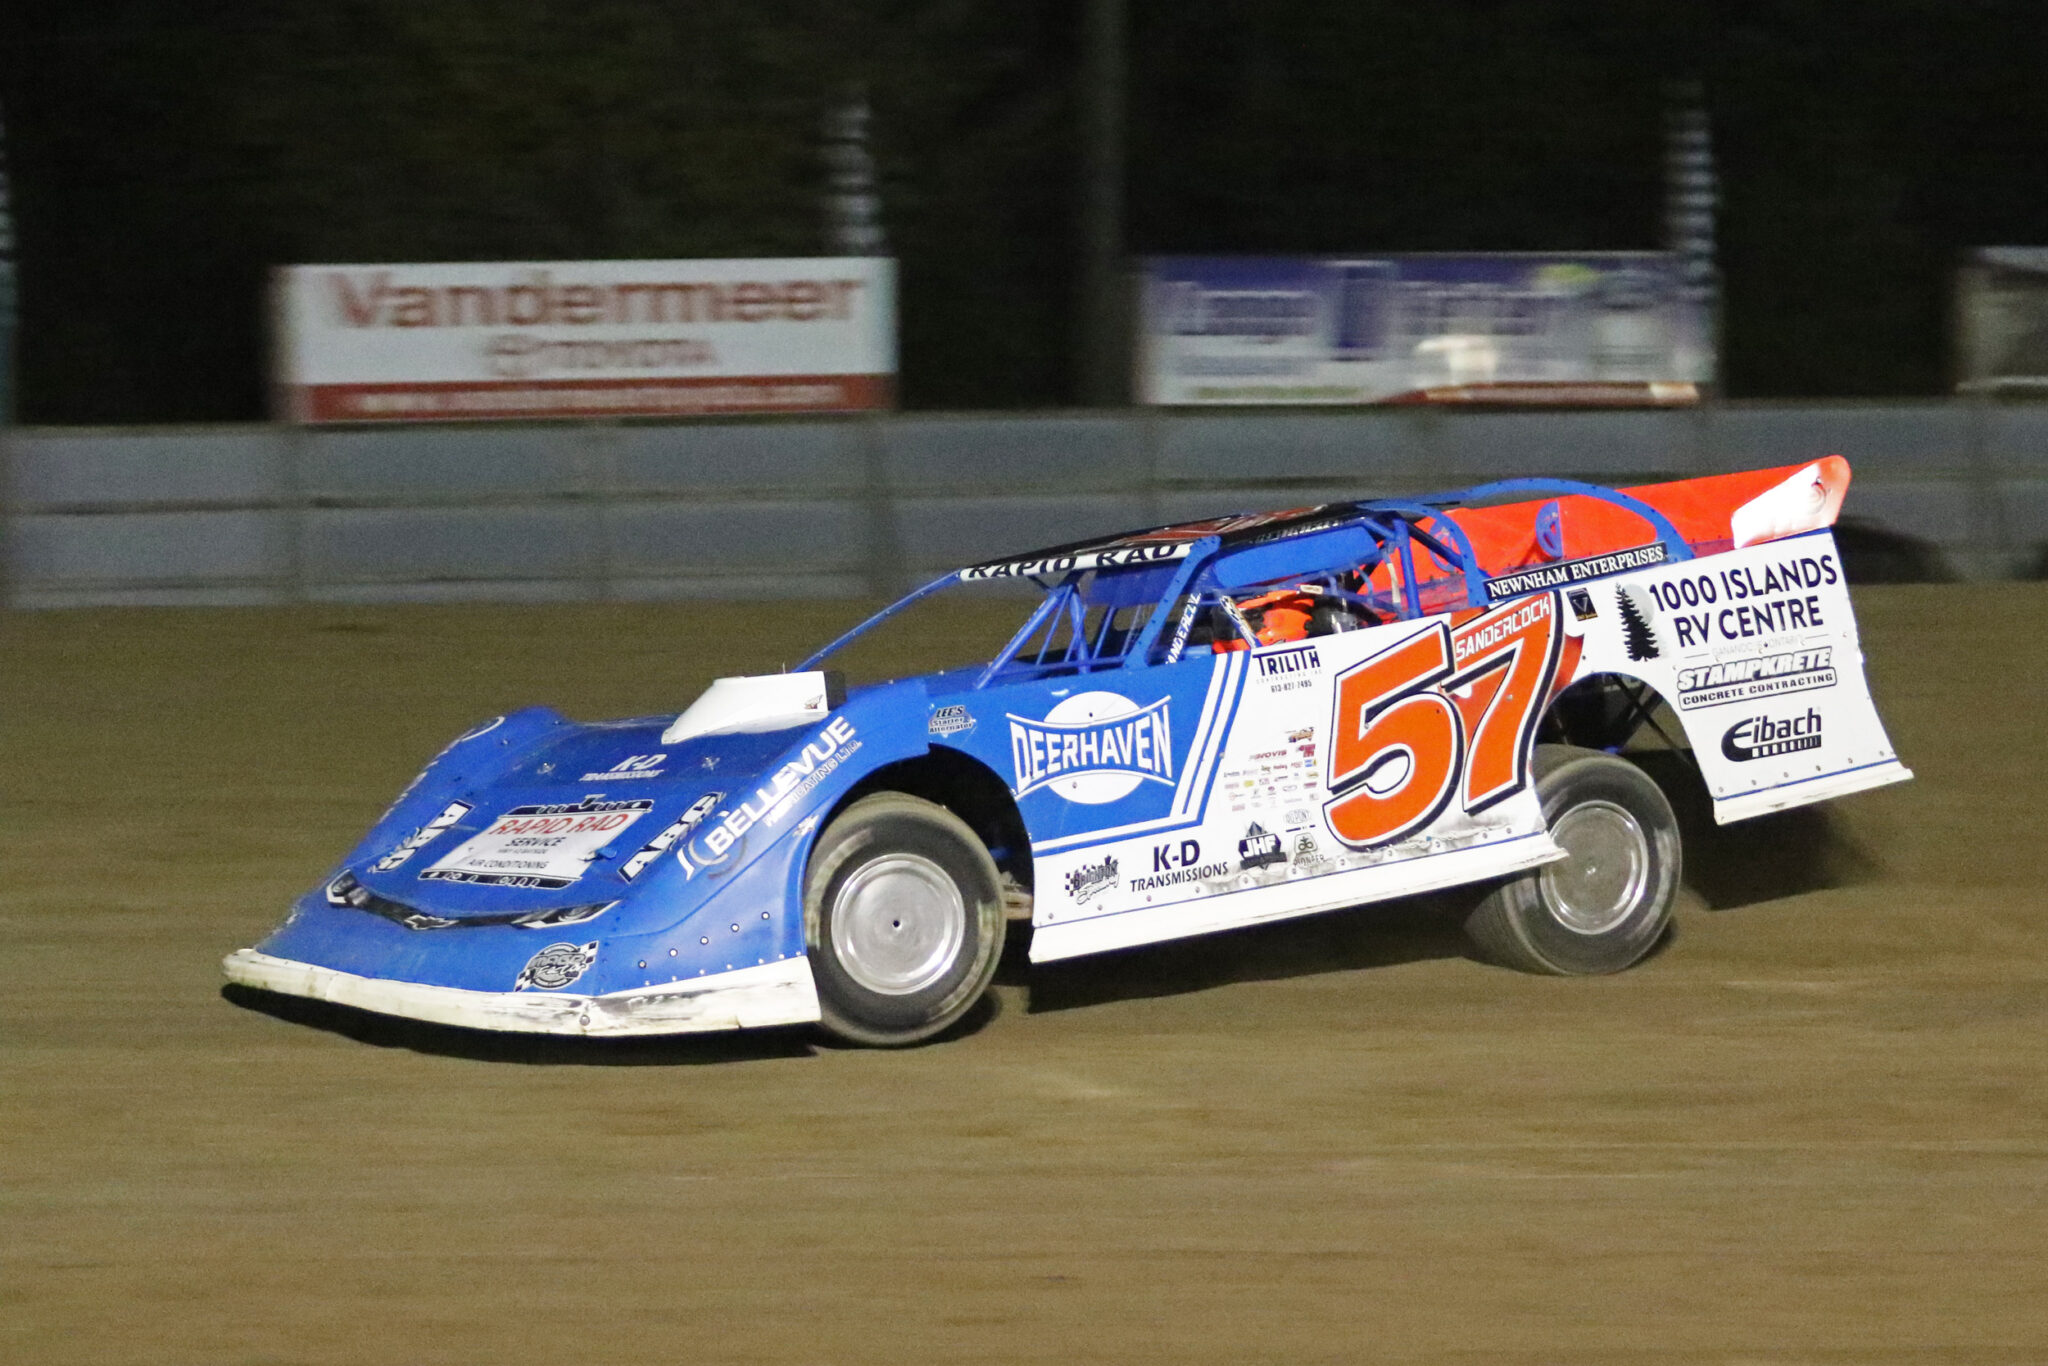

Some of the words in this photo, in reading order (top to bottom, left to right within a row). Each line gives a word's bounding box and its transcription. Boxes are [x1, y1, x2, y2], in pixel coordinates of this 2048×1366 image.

[328, 266, 868, 328] Vandermeer
[968, 556, 1078, 579] RAPID
[1096, 544, 1177, 568] RAD
[1487, 566, 1570, 598] NEWNHAM
[1570, 546, 1665, 580] ENTERPRISES
[1649, 574, 1718, 612] 1000
[1719, 554, 1838, 601] ISLANDS
[1456, 598, 1550, 662] SANDERCOCK
[1673, 613, 1710, 648] RV
[1718, 595, 1824, 641] CENTRE
[1252, 645, 1321, 677] TRILITH
[1677, 646, 1832, 693] STAMPKRETE
[1683, 688, 1745, 706] CONCRETE
[1749, 672, 1834, 695] CONTRACTING
[936, 705, 964, 718] LEE'S
[1322, 590, 1566, 853] 57
[1010, 704, 1173, 793] DEERHAVEN
[1721, 708, 1822, 762] Eibach
[609, 754, 667, 772] K-D
[704, 716, 856, 856] BELLEVUE
[488, 817, 574, 835] RAPID
[567, 813, 630, 833] RAD
[505, 837, 567, 847] SERVICE
[1152, 839, 1201, 873] K-D
[1243, 834, 1277, 857] JHF
[1130, 861, 1229, 893] TRANSMISSIONS
